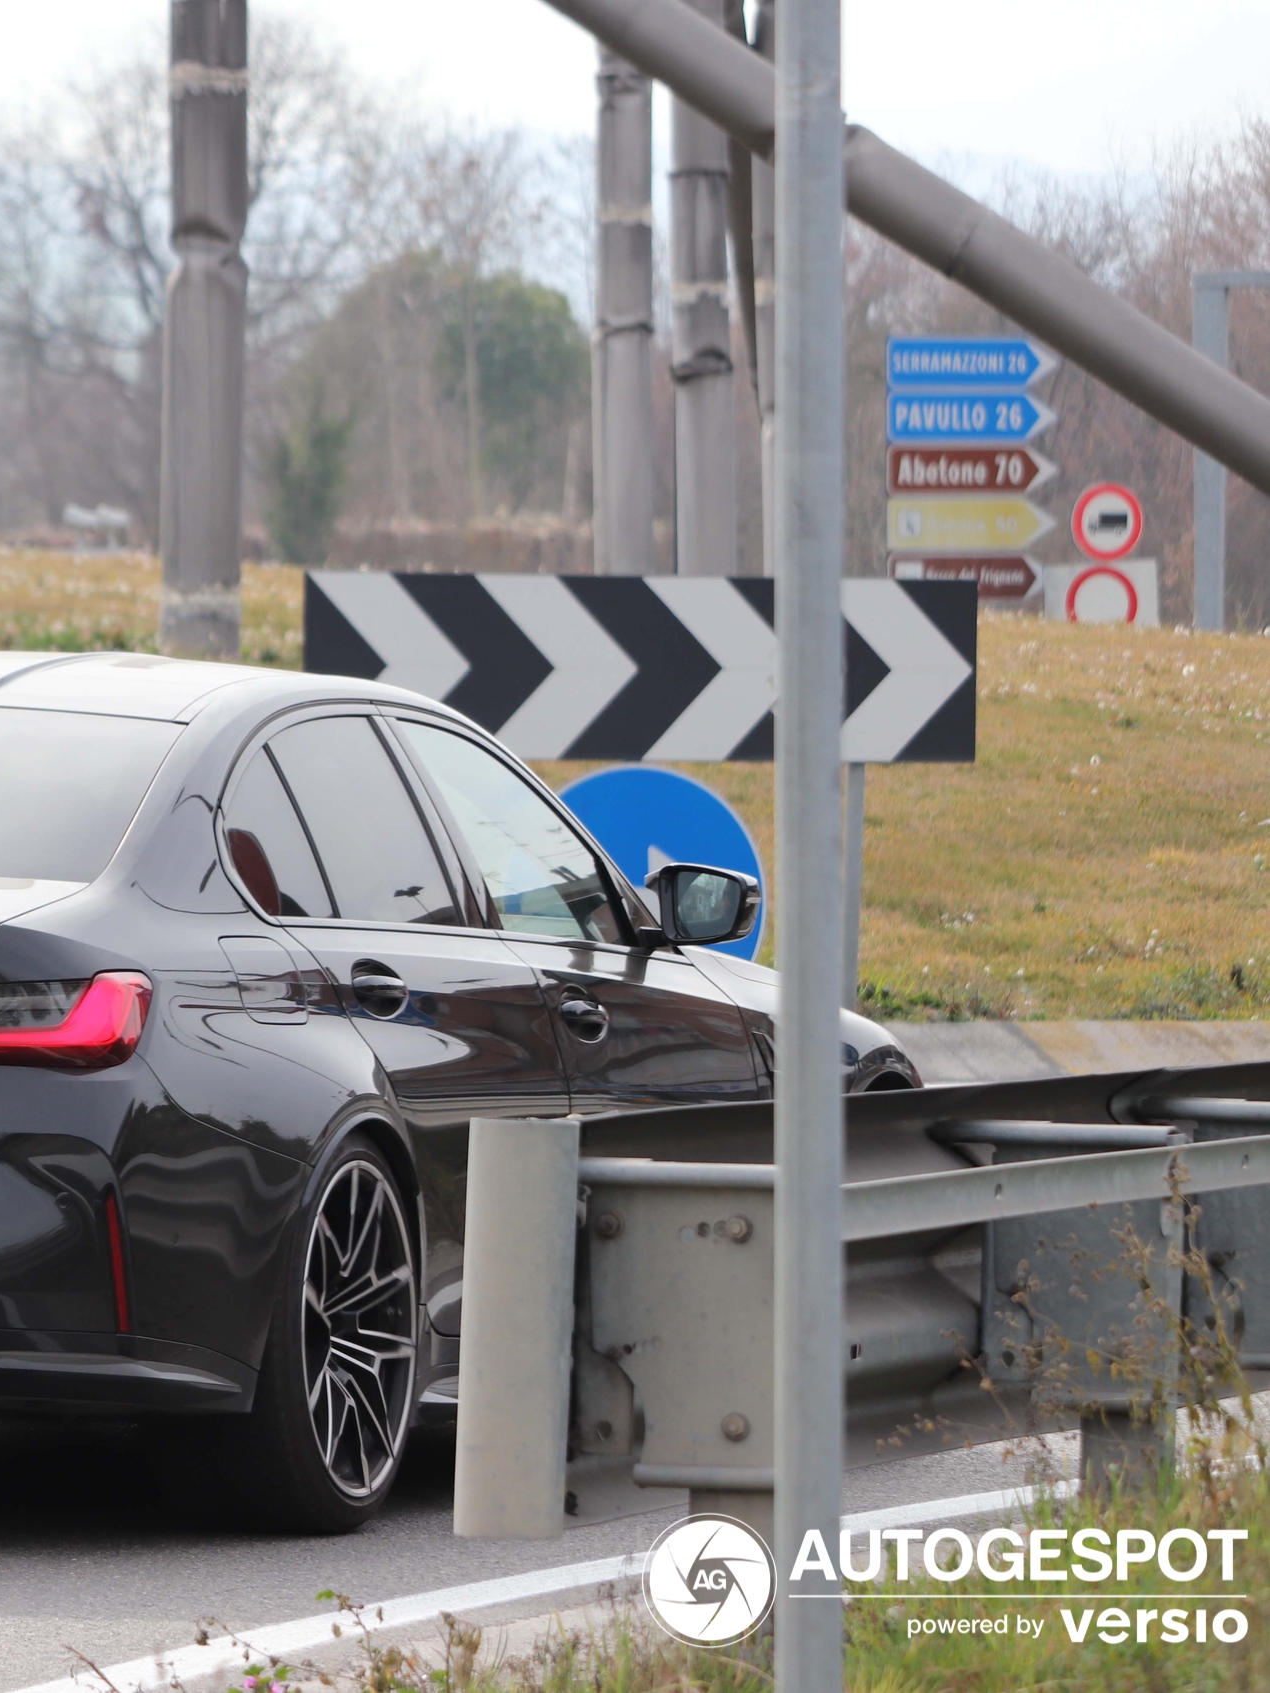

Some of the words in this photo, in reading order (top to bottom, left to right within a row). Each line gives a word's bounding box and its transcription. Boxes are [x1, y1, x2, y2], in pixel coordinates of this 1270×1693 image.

[893, 352, 1003, 374] SERRAMAZZONI
[895, 402, 986, 431] PAVULLO
[995, 402, 1022, 431] 26
[897, 453, 987, 486] Abetone
[994, 453, 1024, 486] 70
